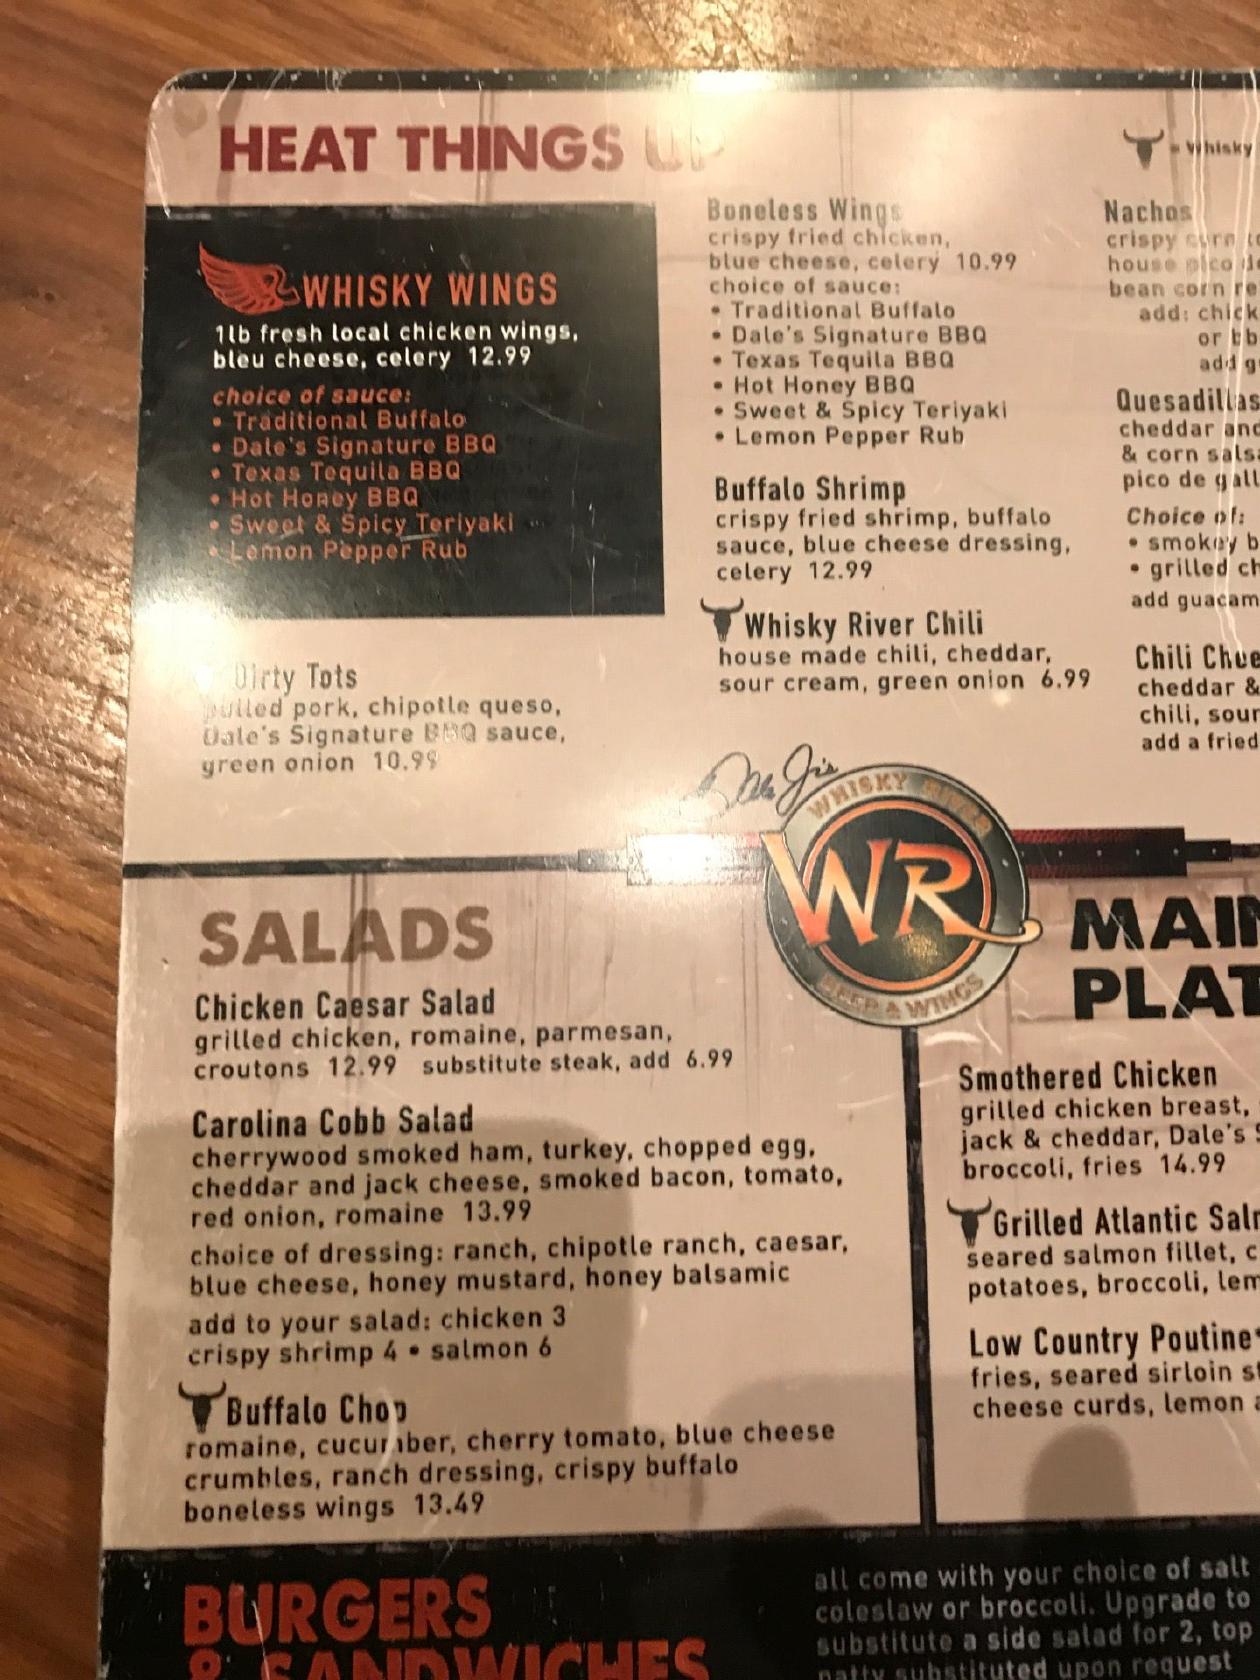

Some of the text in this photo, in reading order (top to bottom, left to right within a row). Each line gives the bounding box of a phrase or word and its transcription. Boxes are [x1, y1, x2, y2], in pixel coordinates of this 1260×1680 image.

[220, 124, 623, 172] HEAT THINGS
[708, 198, 817, 221] Boneless
[1104, 200, 1191, 223] Nachos
[868, 253, 1016, 274] celery 10.99
[303, 272, 556, 308] WHISKY WINGS
[732, 301, 955, 319] Traditional Buffalo
[216, 321, 577, 344] 1lb fresh local chicken wings,
[733, 325, 986, 347] Dale's Signature BBQ
[214, 346, 530, 370] bleu cheese, celery 12.99
[735, 375, 914, 397] Hot Honey BBQ
[735, 400, 1006, 423] Sweet & Spicy Teriyaki
[736, 426, 963, 448] Lemon Pepper Rub
[1120, 419, 1214, 437] cheddar
[233, 434, 495, 459] Dale's Signature BBQ
[716, 476, 905, 507] Buffalo Shrimp
[717, 507, 1050, 532] crispy fried shrimp, buffalo
[1127, 507, 1205, 525] Choice
[717, 533, 1069, 556] sauce, blue cheese dressing,
[717, 561, 872, 584] celery 12.99
[745, 610, 983, 644] Whisky River Chili
[1136, 645, 1191, 669] Chili
[307, 663, 357, 689] Tots
[720, 669, 1089, 695] sour cream, green onion 6.99
[1138, 678, 1234, 697] cheddar
[369, 696, 560, 719] chipotle queso,
[1140, 704, 1260, 726] chili, sour
[809, 770, 908, 821] WHISKY
[199, 906, 493, 966] SALADS
[196, 988, 494, 1021] Chicken Caesar Salad
[195, 1024, 671, 1056] grilled chicken, romaine, parmesan,
[195, 1049, 732, 1080] croutons 12.99 substitute steak, add 6.99
[960, 1060, 1216, 1092] Smothered Chicken
[193, 1104, 473, 1139] Carolina Cobb Salad
[193, 1135, 814, 1172] cherrywood smoked ham, turkey, chopped egg,
[961, 1123, 1245, 1156] jack & cheddar, Dale's
[963, 1152, 1225, 1180] broccoli, fries 14.99
[192, 1165, 842, 1200] cheddar and jack cheese, smoked bacon, tomato,
[994, 1205, 1197, 1237] Grilled Atlantic
[191, 1232, 847, 1267] choice of dressing: ranch, chipotle ranch, caesar,
[969, 1270, 1208, 1303] potatoes, broccoli,
[189, 1305, 565, 1338] add to your salad: chicken 3
[189, 1336, 551, 1369] crispy shrimp 4 salmon 6
[970, 1327, 1138, 1361] Low Country
[972, 1360, 1231, 1390] fries, seared sirloin
[228, 1395, 326, 1426] Buffalo
[973, 1392, 1243, 1418] cheese curds, lemon
[186, 1421, 834, 1459] romaine, cherry tomato, blue cheese
[185, 1492, 484, 1523] boneless wings 13.49
[184, 1574, 491, 1645] BURGERS
